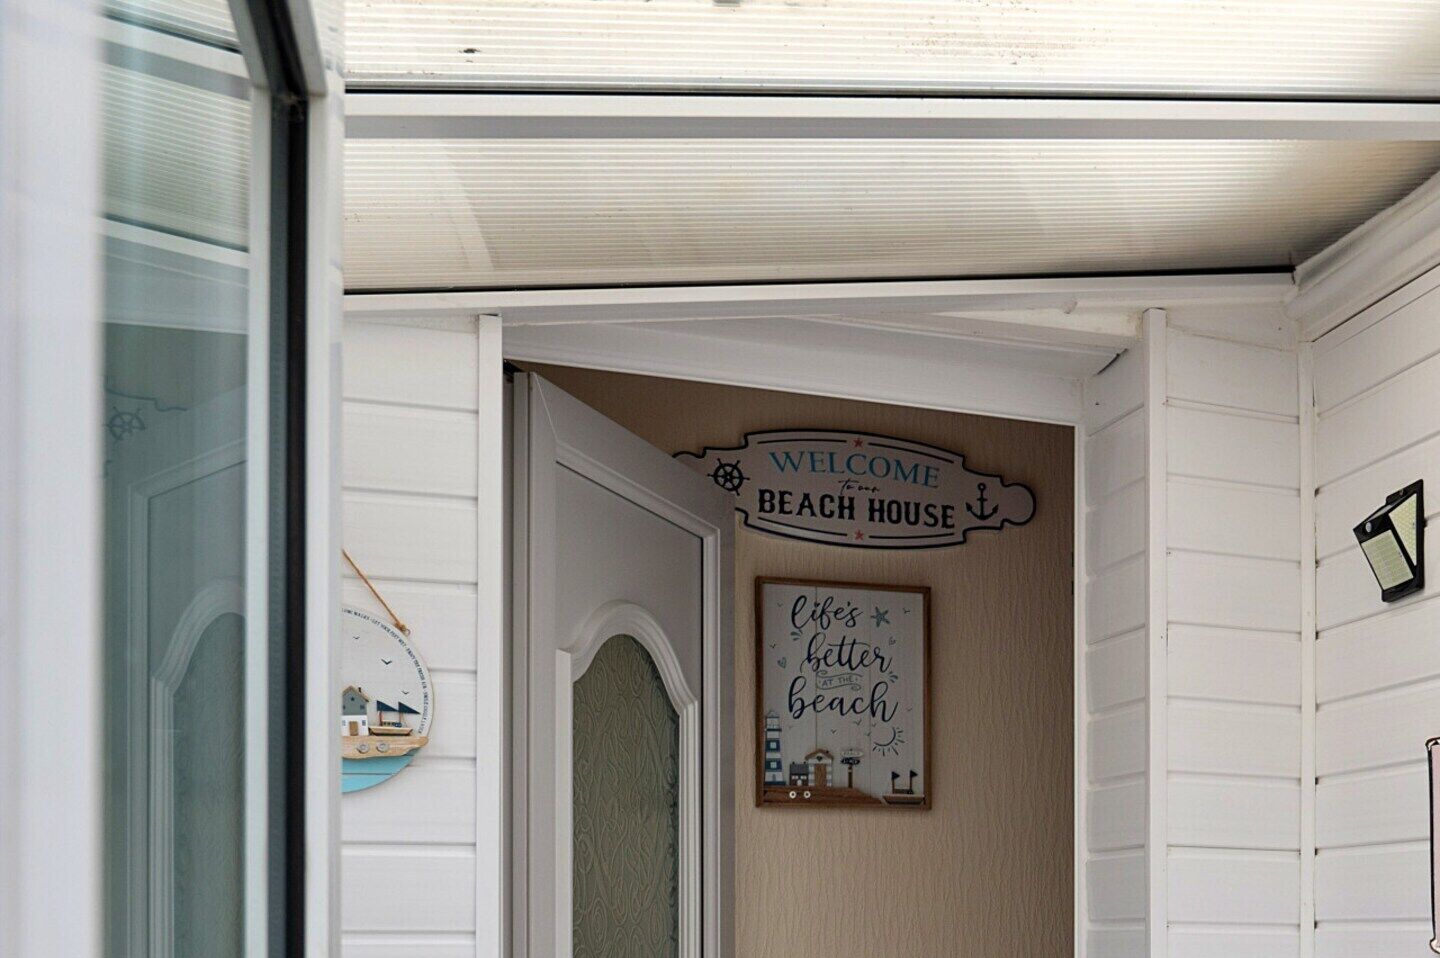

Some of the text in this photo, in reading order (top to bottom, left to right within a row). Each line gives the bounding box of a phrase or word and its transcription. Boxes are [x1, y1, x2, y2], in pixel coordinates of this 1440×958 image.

[769, 451, 939, 489] WELCOME
[758, 488, 955, 529] BEACH HOUSE
[800, 632, 892, 673] better
[788, 675, 899, 722] beach
